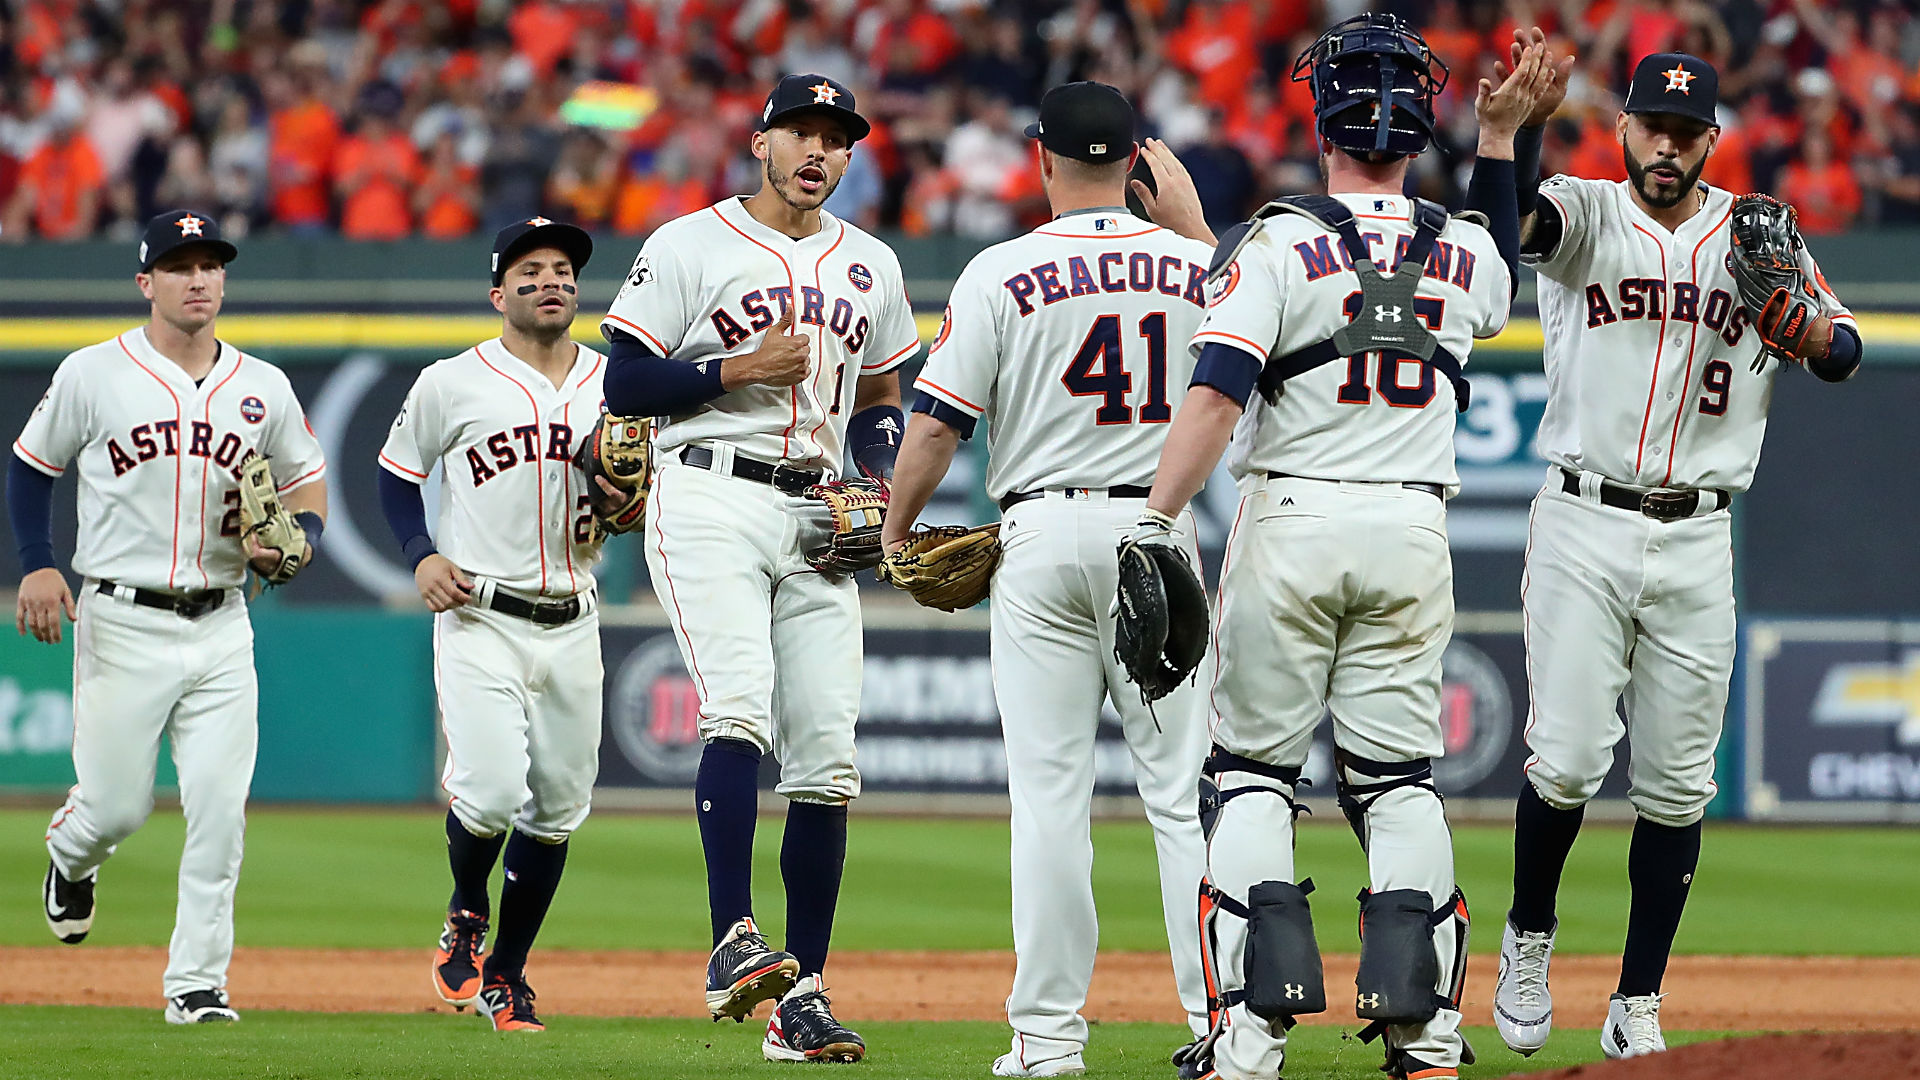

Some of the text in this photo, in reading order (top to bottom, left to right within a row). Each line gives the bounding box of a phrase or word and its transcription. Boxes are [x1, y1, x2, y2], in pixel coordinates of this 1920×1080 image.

[1004, 251, 1208, 317] PEACOCK
[1585, 277, 1751, 347] ASTROS
[710, 285, 870, 355] ASTROS
[1337, 290, 1446, 409] 16
[1783, 305, 1807, 339] Wilson
[829, 362, 846, 416] 1
[1060, 311, 1172, 426] 41
[1698, 360, 1733, 417] 9
[465, 422, 592, 488] ASTR
